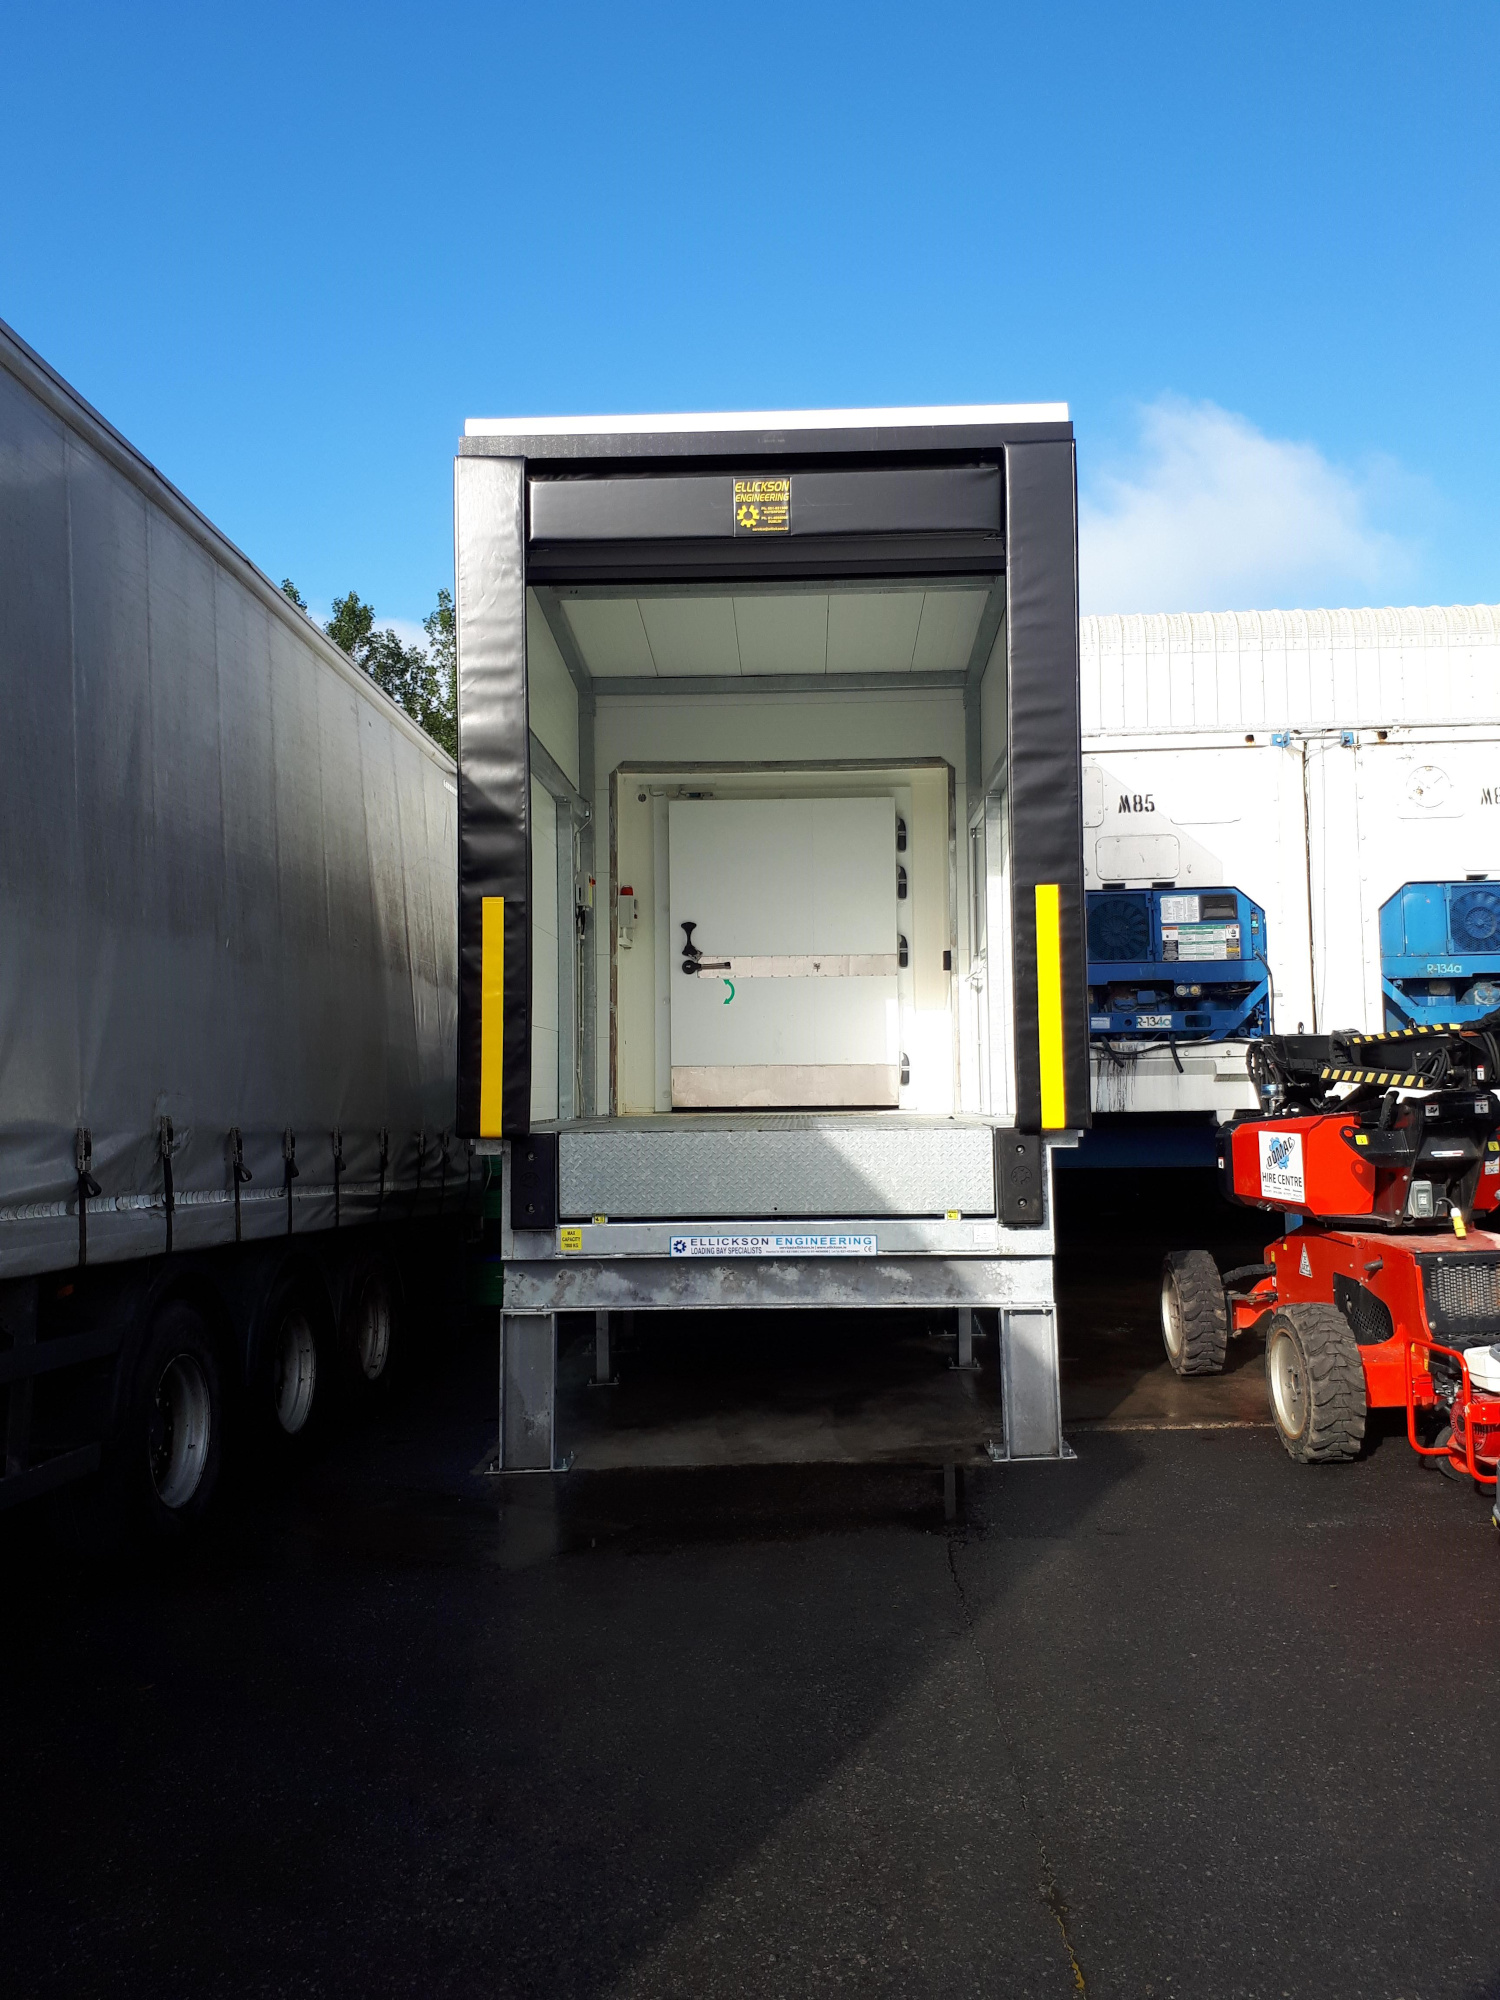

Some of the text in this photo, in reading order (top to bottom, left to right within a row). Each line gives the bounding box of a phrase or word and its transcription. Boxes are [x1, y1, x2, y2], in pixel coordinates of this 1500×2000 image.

[735, 481, 790, 493] ELLICKSON
[735, 493, 789, 502] ENGINEERING
[1118, 794, 1155, 813] M85
[1427, 963, 1462, 974] R-134a
[1136, 1016, 1171, 1027] R-134a
[1262, 1172, 1303, 1188] HIRE CENTRE
[690, 1237, 872, 1246] ELLICKSON ENGINEERING
[690, 1247, 715, 1255] LOADING
[716, 1247, 725, 1255] BAY
[727, 1246, 763, 1255] SPECIALISTS
